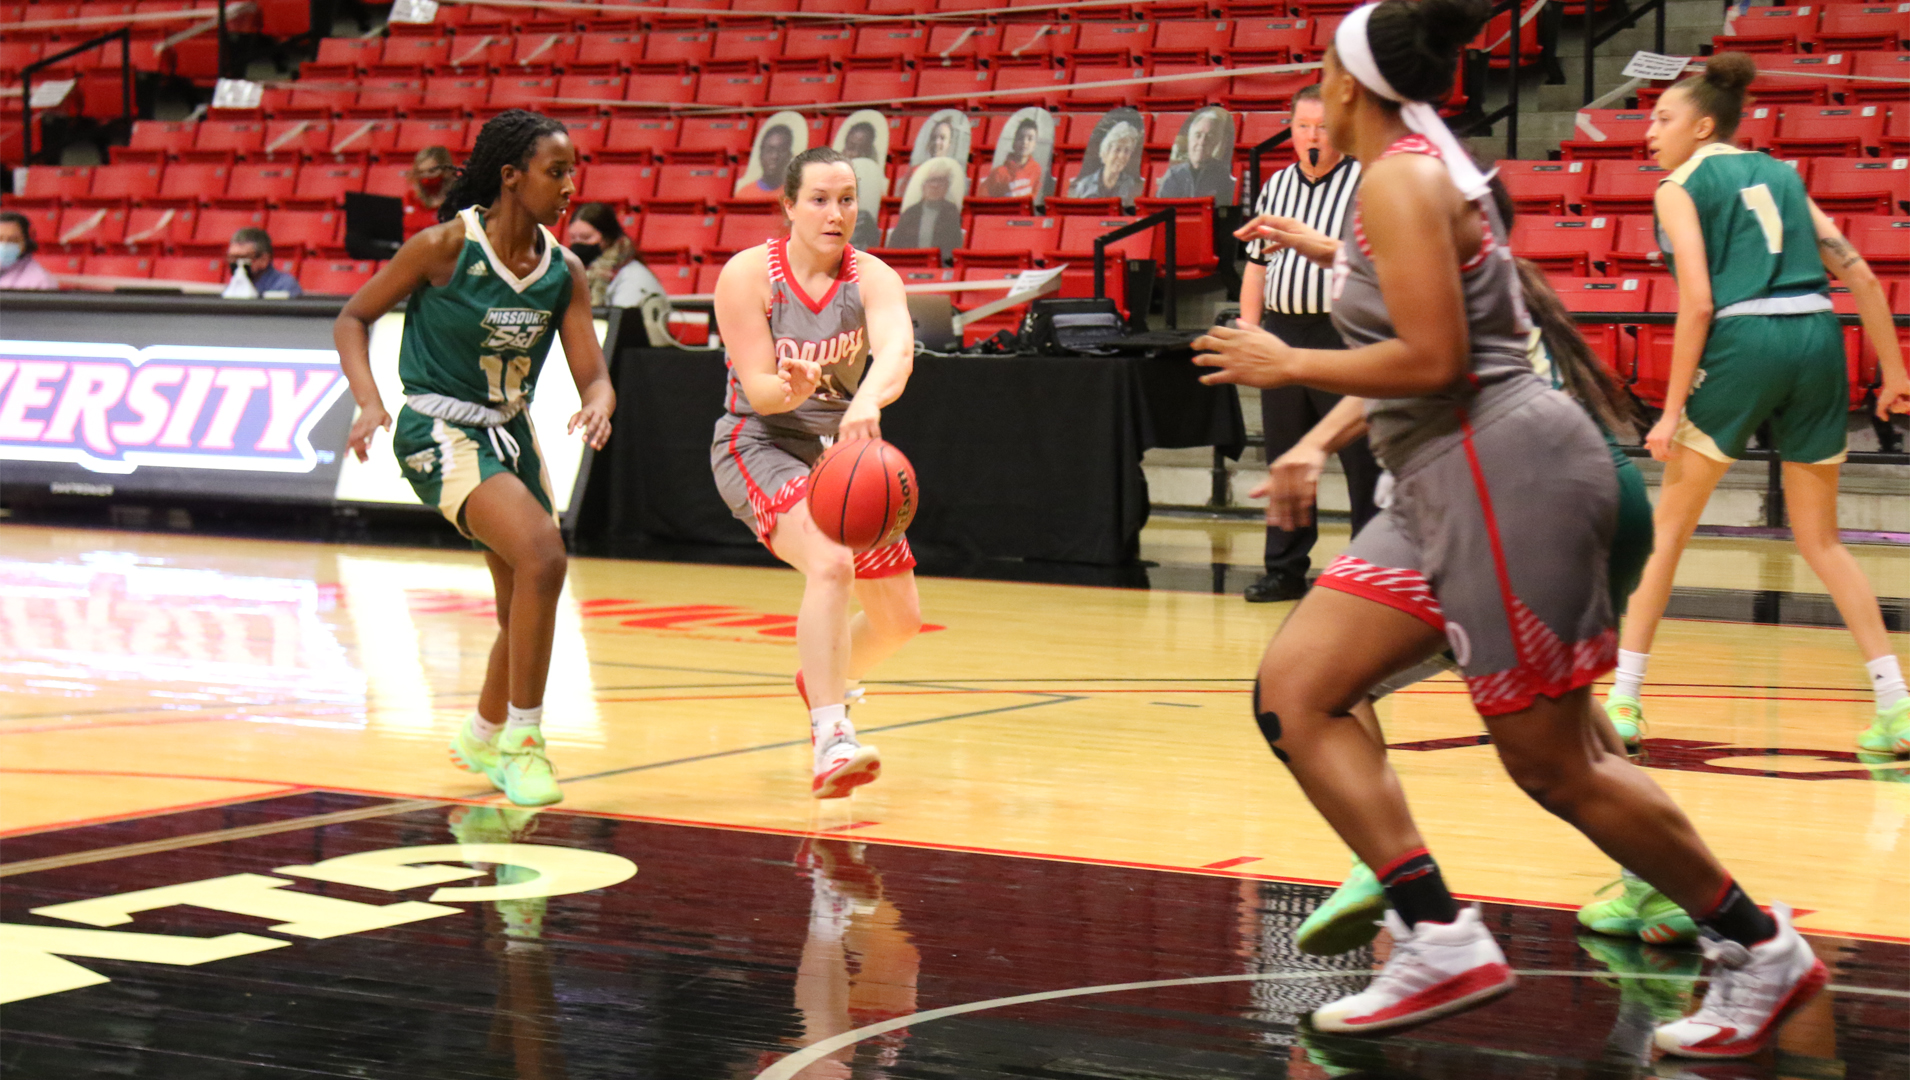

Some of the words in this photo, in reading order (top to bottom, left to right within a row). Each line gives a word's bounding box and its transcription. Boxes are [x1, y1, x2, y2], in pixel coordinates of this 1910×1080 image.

[1740, 183, 1783, 254] 1
[776, 326, 864, 368] Drury
[0, 358, 338, 455] ERSITY
